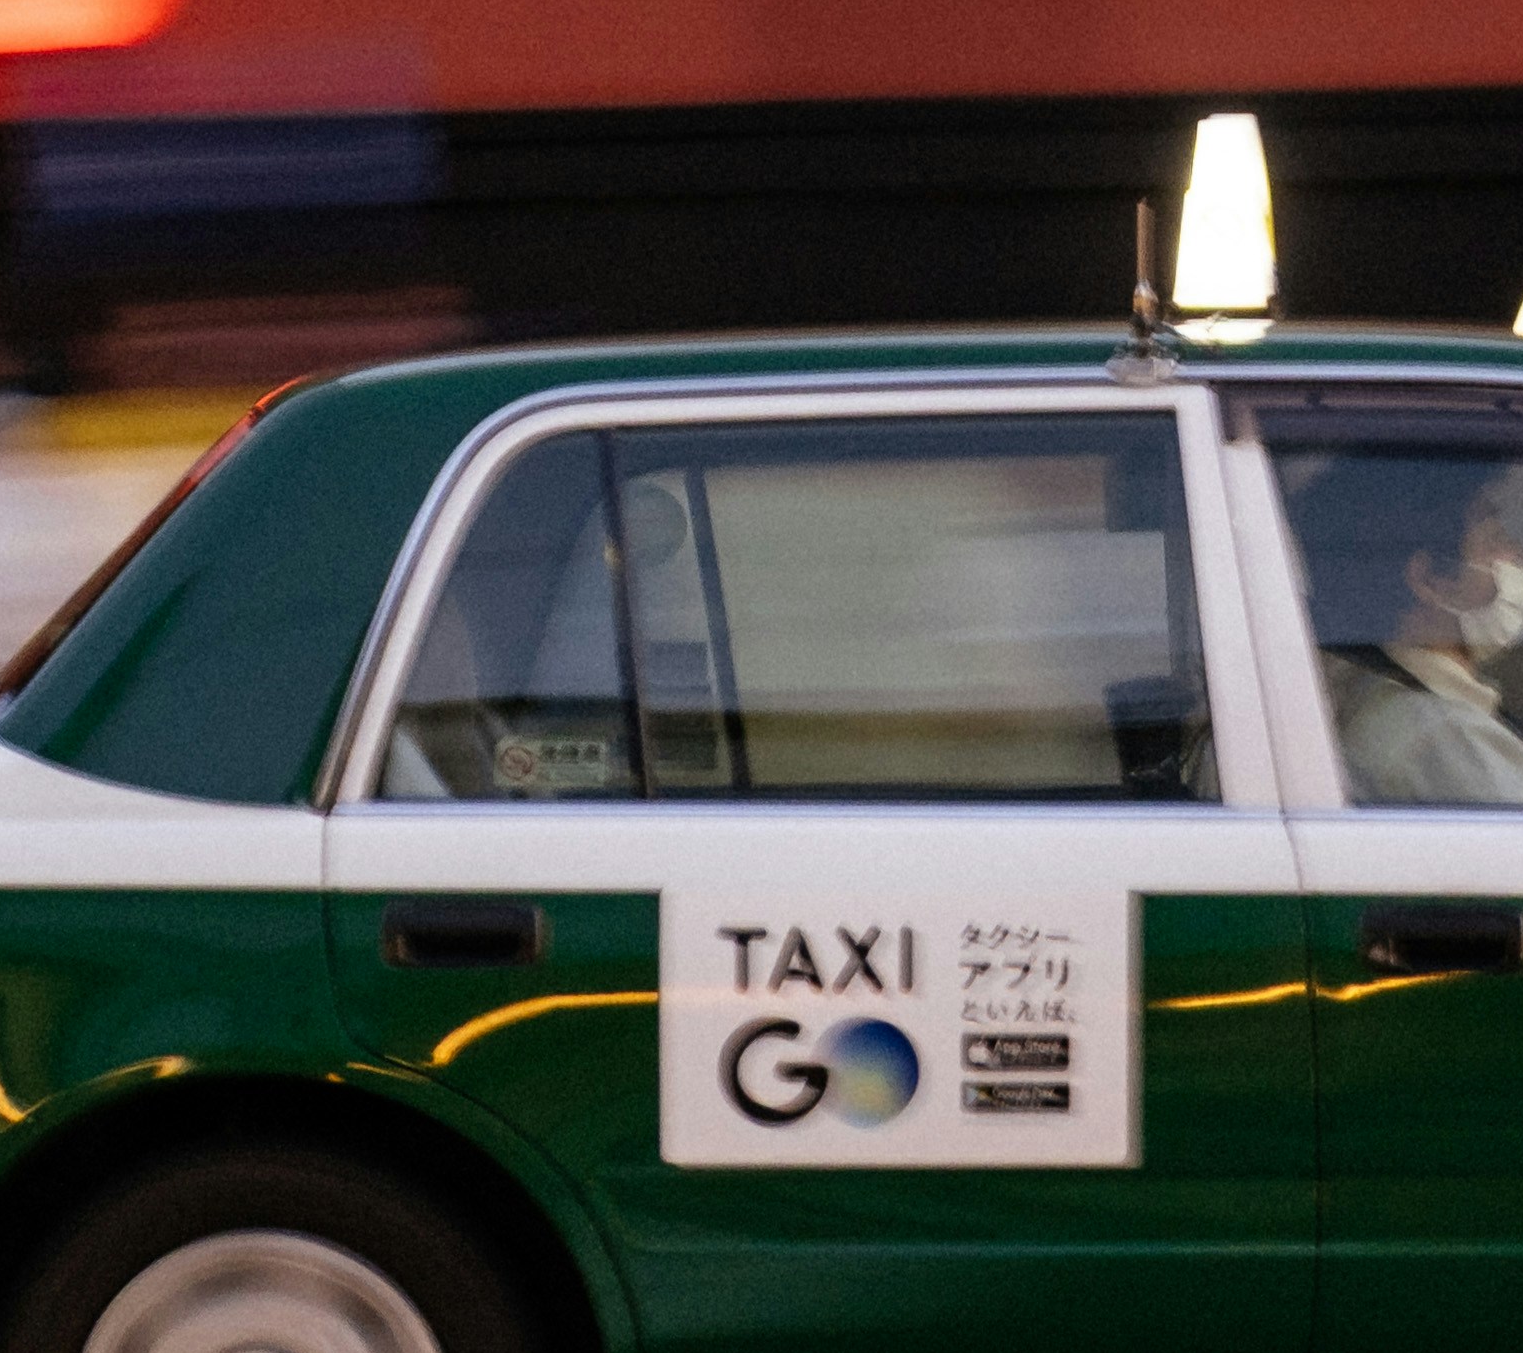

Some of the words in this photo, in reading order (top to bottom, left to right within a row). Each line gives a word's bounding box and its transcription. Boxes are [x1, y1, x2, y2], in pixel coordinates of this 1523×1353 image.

[716, 926, 915, 993] TAXI
[960, 924, 1070, 950] タクシー
